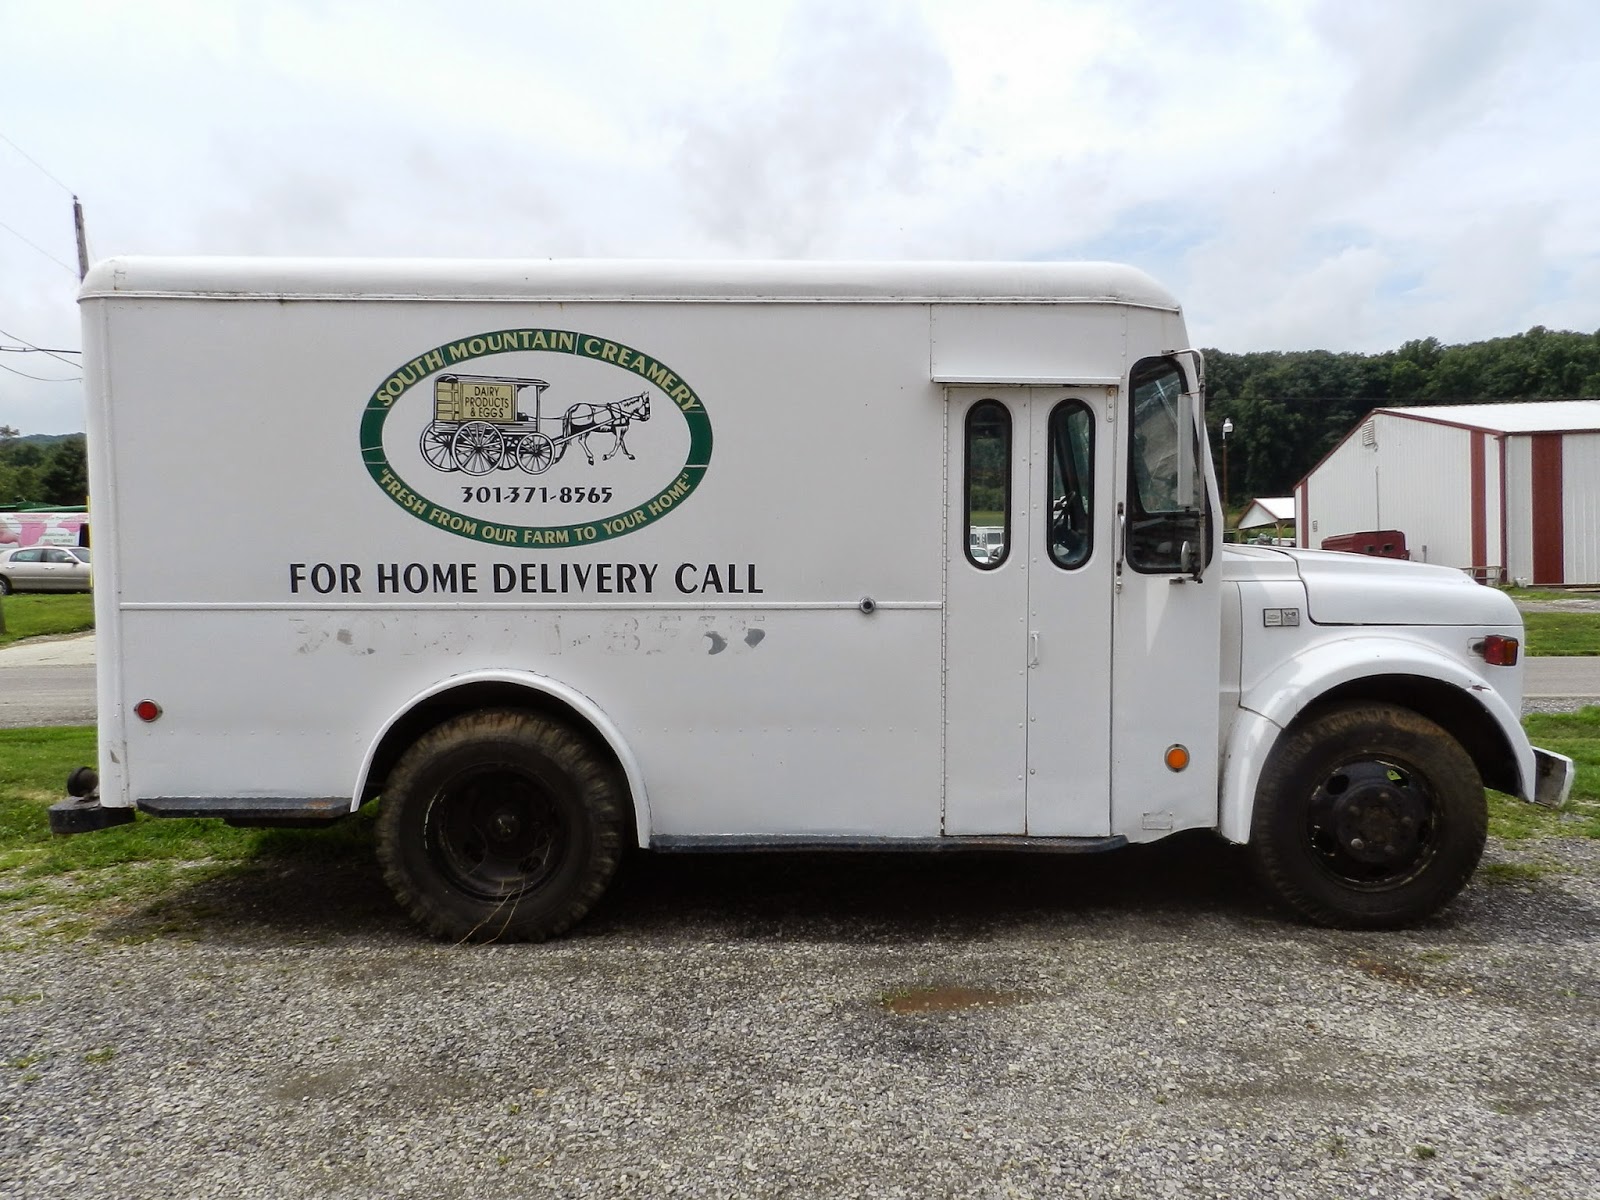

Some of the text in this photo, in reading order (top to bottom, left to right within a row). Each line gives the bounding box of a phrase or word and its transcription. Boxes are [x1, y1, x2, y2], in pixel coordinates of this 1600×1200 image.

[377, 331, 700, 411] SOUTH MOUNTAIN CREAMERY
[474, 386, 500, 396] DAIRY
[464, 396, 510, 408] PRODUCTS
[470, 407, 504, 418] & EGGS
[460, 486, 613, 503] 301-371-8565
[428, 508, 478, 535] FROM
[481, 525, 518, 543] OUR
[523, 529, 570, 544] FARM
[573, 526, 597, 541] TO
[602, 509, 648, 535] YOUR
[290, 563, 764, 593] FOR HOME DELIVERY CALL
